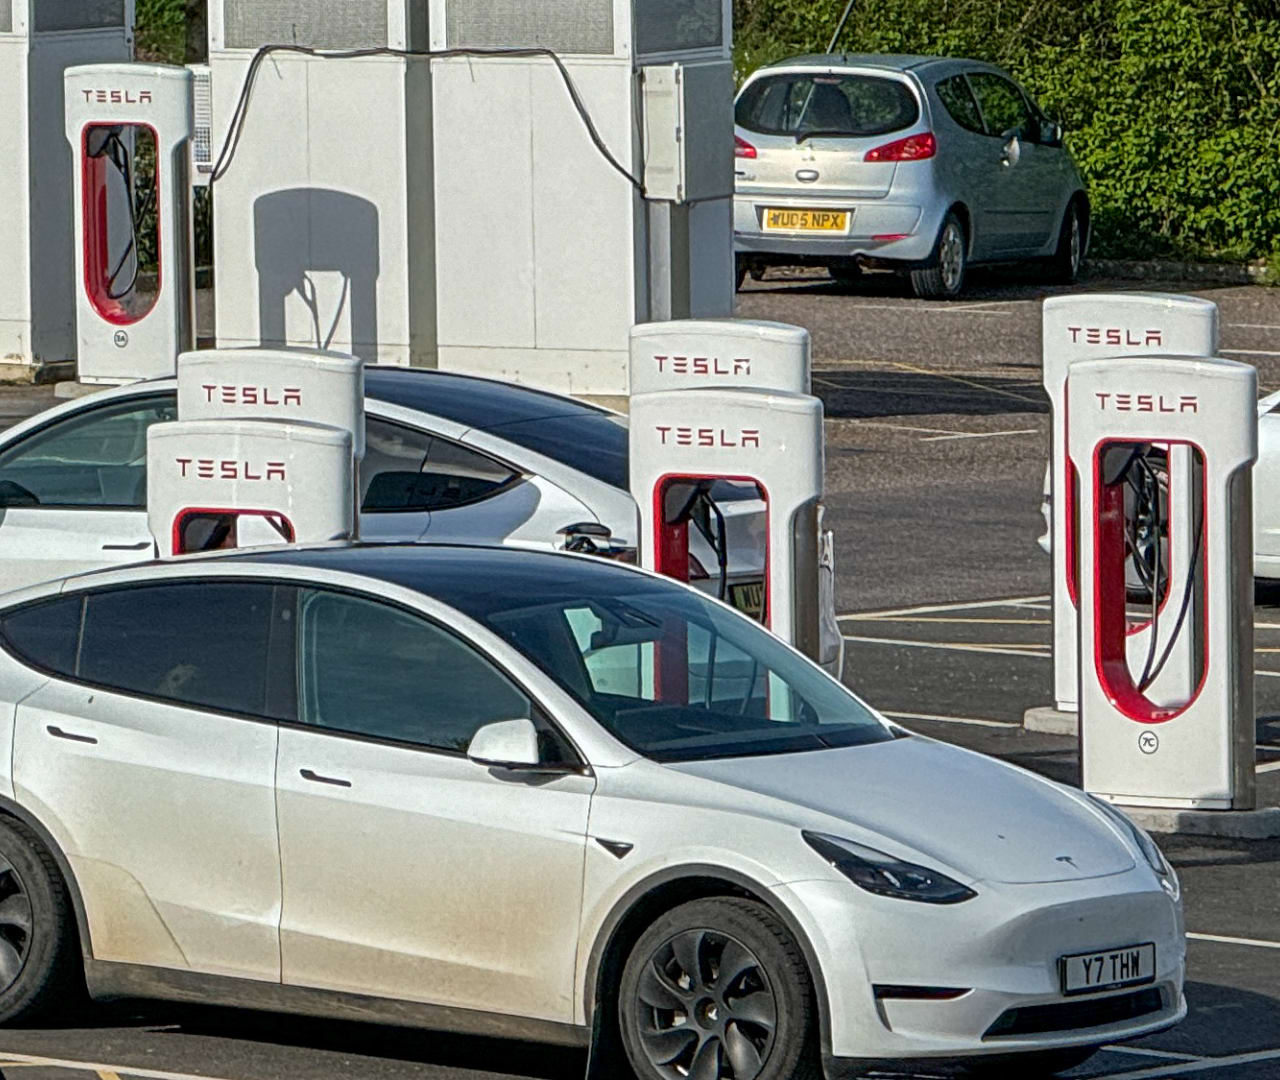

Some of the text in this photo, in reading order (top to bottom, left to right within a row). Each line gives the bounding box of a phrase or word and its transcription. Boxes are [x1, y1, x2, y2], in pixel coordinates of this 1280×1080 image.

[82, 90, 151, 104] TESLA
[812, 213, 840, 228] NPX
[1068, 327, 1161, 346] TESLA
[654, 356, 750, 375] TESLA
[202, 385, 301, 406] TESLA
[1096, 393, 1197, 413] TESLA
[656, 427, 759, 448] TESLA
[176, 458, 286, 480] TESLA
[1082, 950, 1140, 985] Y7 THW
